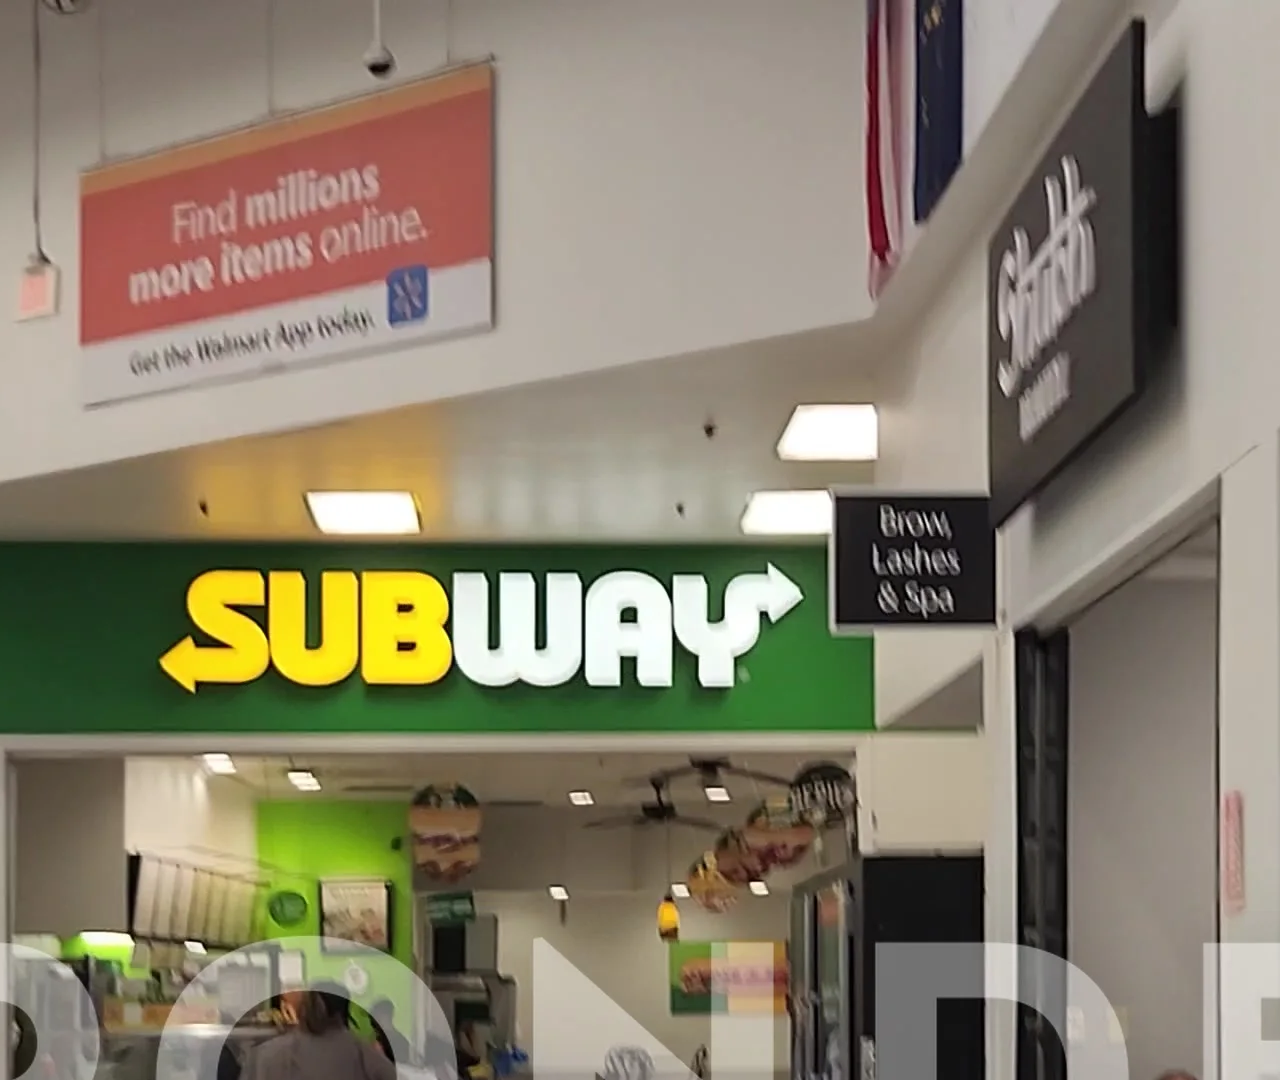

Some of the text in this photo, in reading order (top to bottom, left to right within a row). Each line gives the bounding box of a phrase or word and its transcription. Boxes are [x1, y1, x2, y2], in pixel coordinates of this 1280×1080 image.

[172, 163, 380, 245] Find millions
[128, 205, 429, 305] more items online.
[129, 350, 160, 377] Get
[196, 326, 272, 364] Walmart
[871, 541, 961, 577] Lashes
[158, 562, 804, 694] SUBWAY
[877, 579, 955, 620] & Spa
